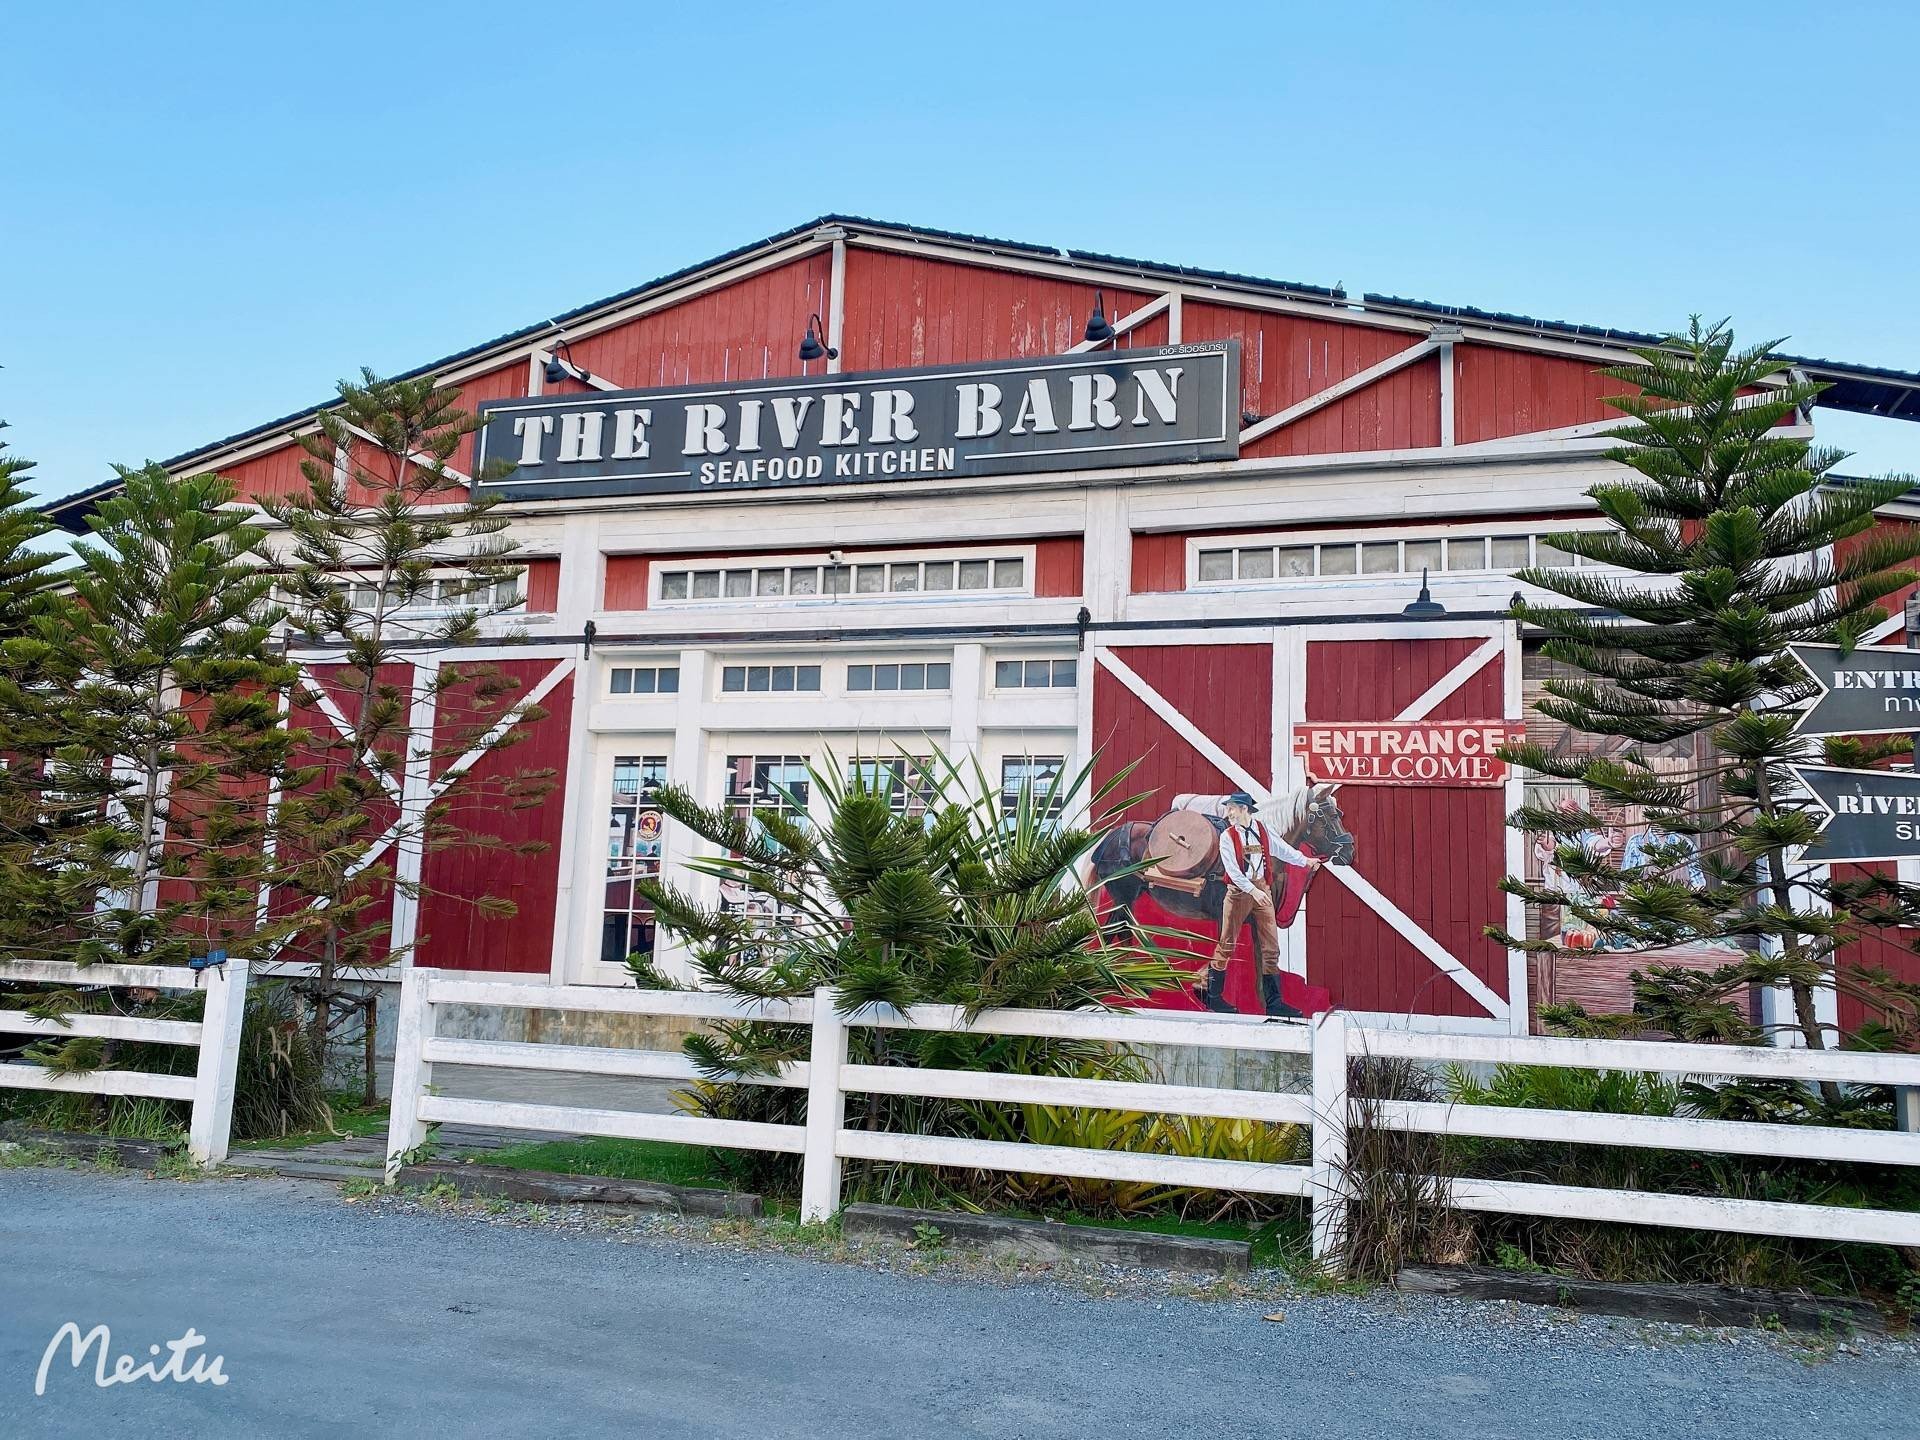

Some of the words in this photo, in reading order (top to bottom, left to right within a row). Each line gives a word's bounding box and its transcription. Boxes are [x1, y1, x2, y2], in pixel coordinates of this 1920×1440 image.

[513, 408, 651, 467] THE
[681, 389, 919, 456] RIVER
[954, 367, 1185, 440] BARN
[699, 455, 823, 485] SEAFOOD
[834, 447, 955, 477] KITCHEN
[1311, 728, 1505, 755] ENTRANCE
[1321, 756, 1494, 779] WELCOME
[1837, 795, 1920, 815] RIVE
